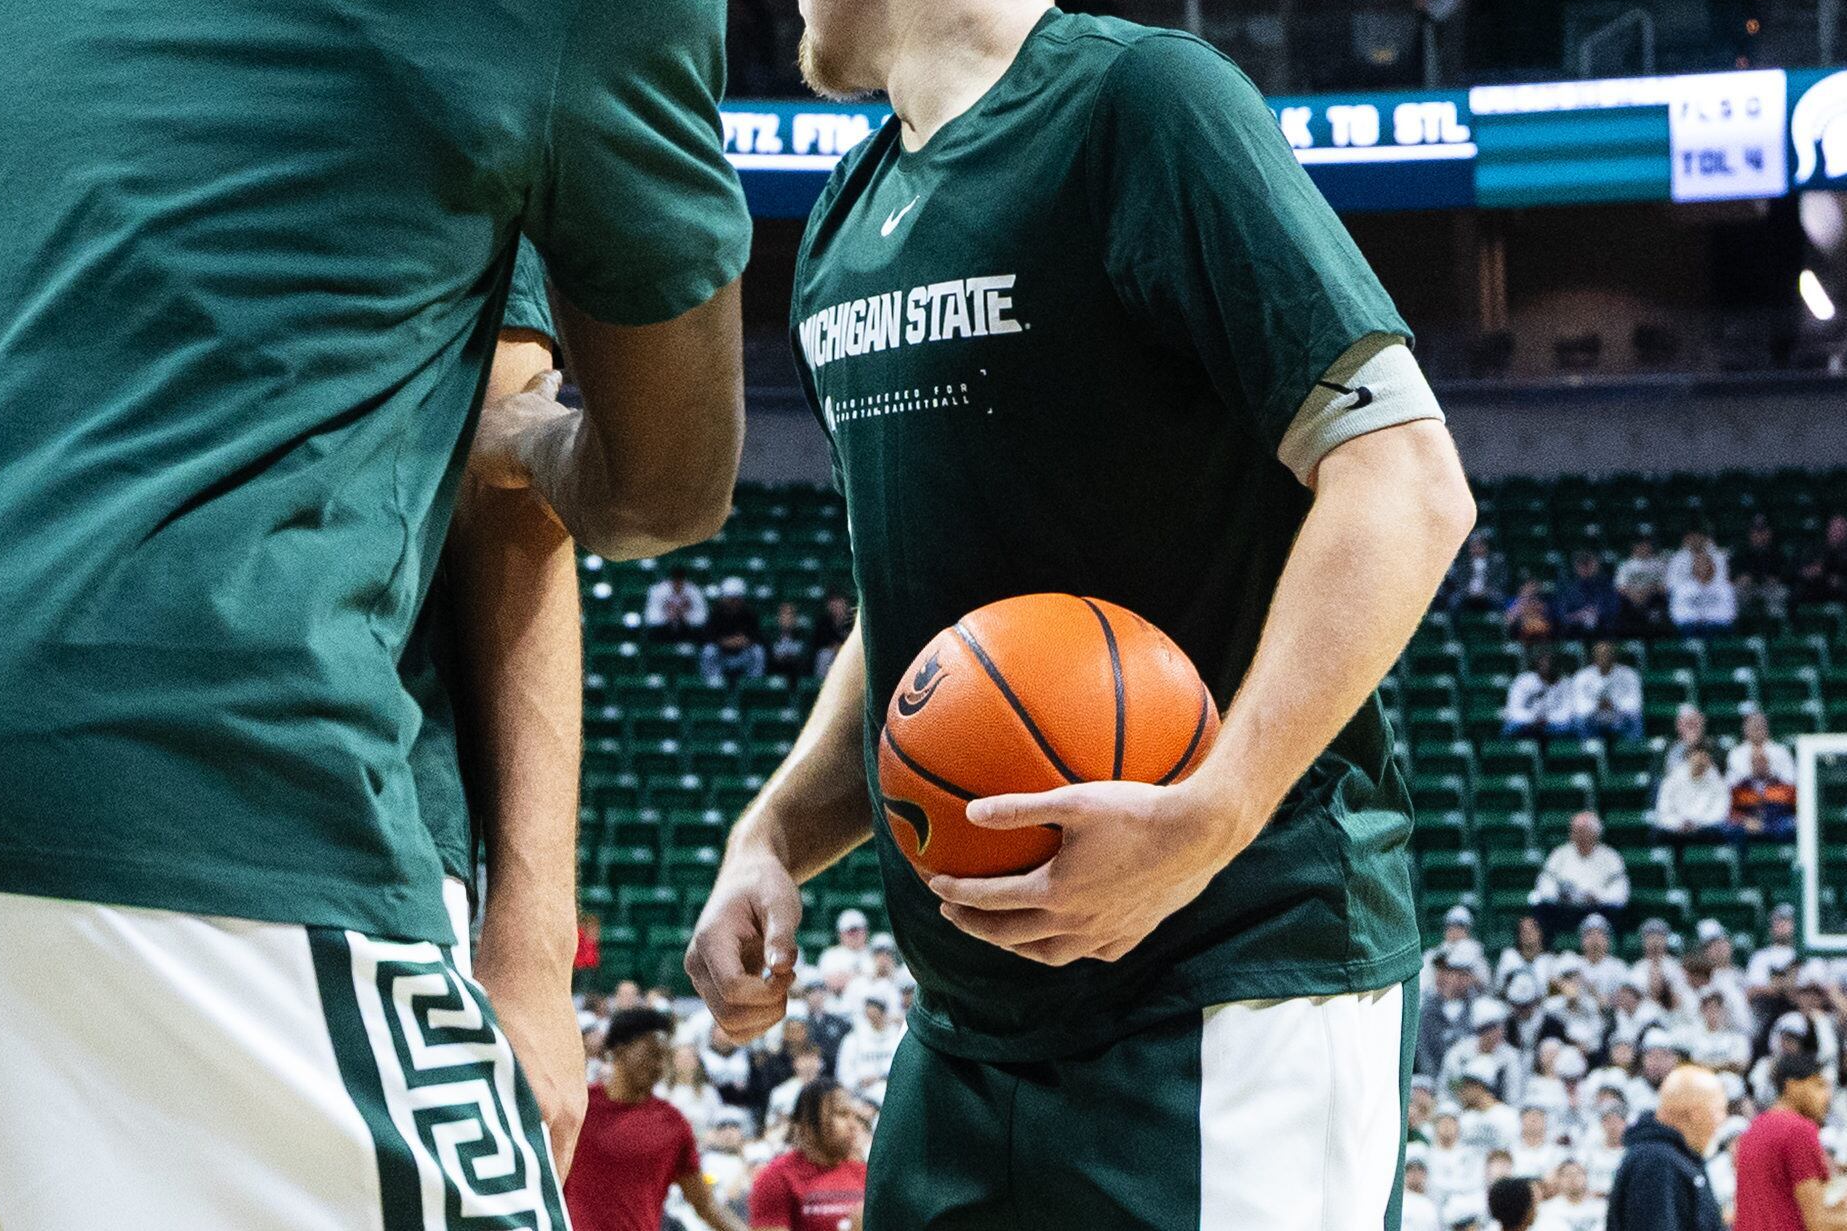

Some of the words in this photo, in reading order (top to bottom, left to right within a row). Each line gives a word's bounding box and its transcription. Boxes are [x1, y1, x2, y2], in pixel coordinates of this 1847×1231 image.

[799, 291, 903, 370] MICHIGAN
[905, 274, 1023, 345] STATE
[934, 383, 968, 396] FOR
[884, 396, 969, 415] BASKETBALL
